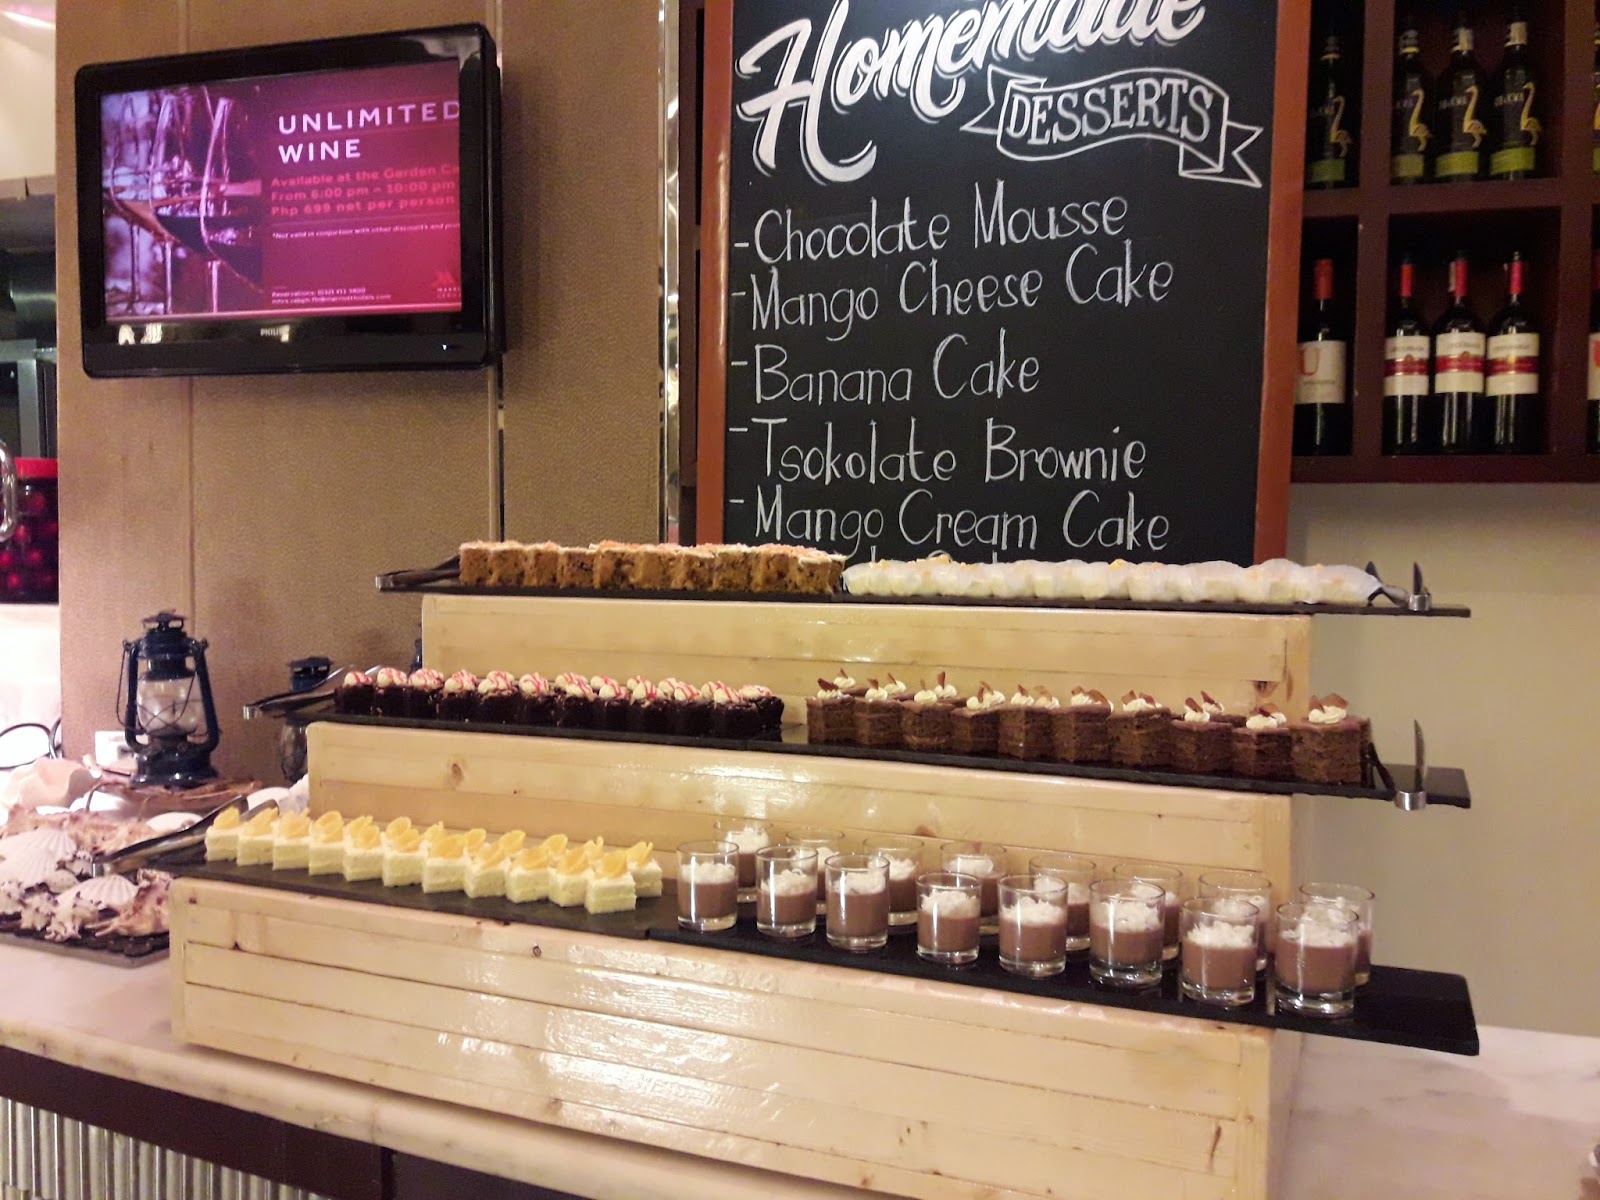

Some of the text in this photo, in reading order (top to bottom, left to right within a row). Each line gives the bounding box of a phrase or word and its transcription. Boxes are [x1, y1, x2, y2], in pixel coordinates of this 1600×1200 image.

[278, 101, 460, 135] UNLIMITED
[1006, 77, 1212, 146] DESSERTS
[271, 174, 334, 188] Available
[337, 172, 351, 183] at
[355, 170, 380, 181] the
[384, 165, 438, 180] Garden
[278, 138, 361, 164] WINE
[271, 192, 307, 202] From
[311, 187, 343, 199] 6:00
[347, 187, 369, 198] pm
[387, 181, 429, 195] 10:00
[432, 181, 457, 192] pm
[271, 206, 299, 217] Php
[367, 200, 393, 211] per
[755, 197, 950, 264] Chocolate
[974, 179, 1128, 249] Mousse
[751, 265, 879, 342] Mango
[900, 258, 1043, 316] Cheese
[1067, 238, 1174, 307] Cake
[755, 344, 912, 406] Banana
[933, 328, 1040, 398] Cake
[751, 418, 957, 485] Tsokolate
[985, 418, 1147, 483] Brownie
[755, 484, 884, 556] Mango
[900, 489, 1038, 550] Cream
[1063, 489, 1169, 550] Cake
